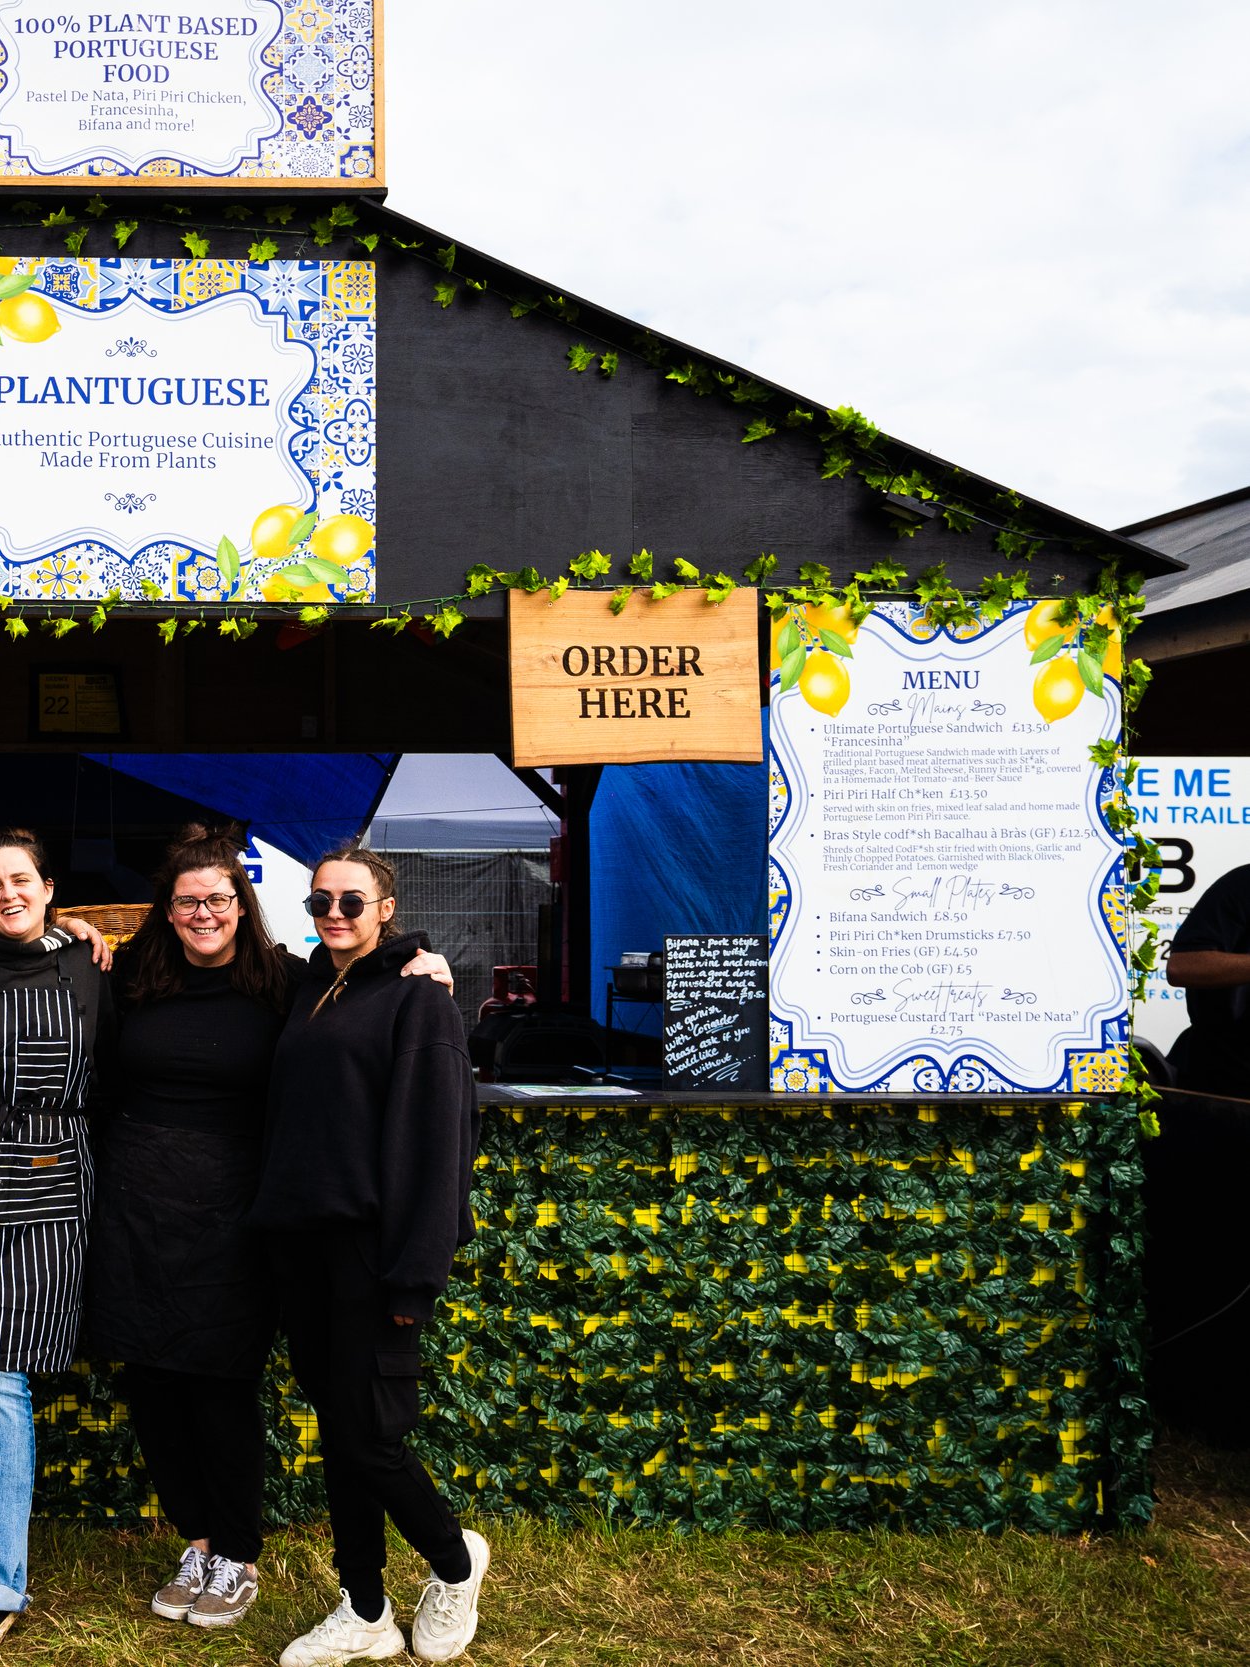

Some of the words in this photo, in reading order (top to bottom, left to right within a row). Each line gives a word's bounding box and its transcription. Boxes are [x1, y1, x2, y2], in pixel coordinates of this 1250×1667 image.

[14, 15, 80, 34] 100%
[88, 14, 170, 34] PLANT
[177, 17, 257, 36] BASED
[53, 39, 218, 59] PORTUGUESE
[102, 64, 169, 83] FOOD
[26, 90, 67, 102] Pastel
[70, 90, 88, 102] De
[92, 90, 128, 104] Nata,
[132, 90, 156, 103] Piri
[160, 91, 184, 103] Piri
[187, 91, 246, 105] Chicken,
[90, 104, 178, 118] Francesinha,
[78, 119, 122, 131] Bifana
[125, 119, 150, 131] and
[154, 119, 194, 132] more!
[87, 430, 197, 452] Portuguese
[202, 431, 274, 449] Cuisine
[39, 451, 93, 468] Made
[98, 452, 150, 468] From
[156, 452, 216, 469] Plants
[561, 645, 704, 677] ORDER
[902, 670, 980, 690] MENU
[44, 696, 70, 714] 22
[577, 688, 691, 719] HERE
[907, 692, 967, 725] Mains
[823, 724, 874, 734] Ultimate
[877, 723, 943, 736] Portuguese
[945, 723, 1002, 732] Sandwich
[1011, 722, 1051, 734] £13.50
[822, 749, 872, 757] Traditional
[874, 748, 924, 759] Portuguese
[926, 748, 969, 756] Sandwich
[971, 747, 995, 756] made
[997, 747, 1017, 755] with
[1019, 747, 1049, 758] Layers
[1050, 747, 1060, 755] of
[1174, 769, 1231, 796] ME
[823, 789, 844, 799] Piri
[847, 789, 867, 799] Piri
[870, 789, 896, 798] Half
[949, 788, 987, 800] £13.50
[822, 804, 852, 812] Served
[854, 804, 874, 812] with
[876, 803, 895, 812] skin
[935, 803, 964, 811] mixed
[965, 802, 982, 811] leaf
[984, 802, 1007, 810] salad
[1009, 802, 1026, 810] and
[1028, 802, 1053, 810] home
[1055, 802, 1080, 810] made
[822, 813, 873, 823] Portuguese
[874, 812, 905, 820] Lemon
[907, 812, 923, 820] Piri
[925, 812, 941, 820] Piri
[823, 830, 849, 840] Bras
[852, 830, 881, 842] Style
[934, 829, 988, 839] Bacalhau
[990, 829, 997, 838] à
[1000, 829, 1026, 838] Bràs
[1029, 828, 1056, 841] (GF)
[1058, 828, 1099, 840] £12.50
[829, 912, 867, 922] Bifana
[870, 912, 927, 921] Sandwich
[933, 911, 967, 923] £8.50
[829, 930, 850, 940] Piri
[853, 930, 874, 940] Piri
[925, 930, 994, 940] Drumsticks
[997, 930, 1031, 942] £7.50
[829, 946, 878, 956] Skin-on
[881, 946, 910, 956] Fries
[913, 946, 940, 959] (GF)
[943, 946, 978, 958] £4.50
[723, 958, 742, 966] and
[707, 970, 730, 982] good
[732, 968, 756, 977] dose
[829, 965, 858, 974] Corn
[878, 964, 898, 974] the
[900, 964, 923, 974] Cob
[926, 964, 953, 977] (GF)
[956, 964, 972, 976] £5
[726, 979, 746, 987] and
[690, 990, 701, 1000] of
[666, 1022, 683, 1036] We
[684, 1006, 722, 1031] garnish
[830, 1012, 897, 1025] Portuguese
[899, 1012, 946, 1022] Custard
[948, 1012, 974, 1022] Tart
[1025, 1012, 1040, 1021] De
[930, 1025, 963, 1036] £2.75
[700, 1036, 720, 1048] ask
[722, 1032, 731, 1042] if
[668, 1054, 700, 1076] would
[699, 1048, 719, 1060] like
